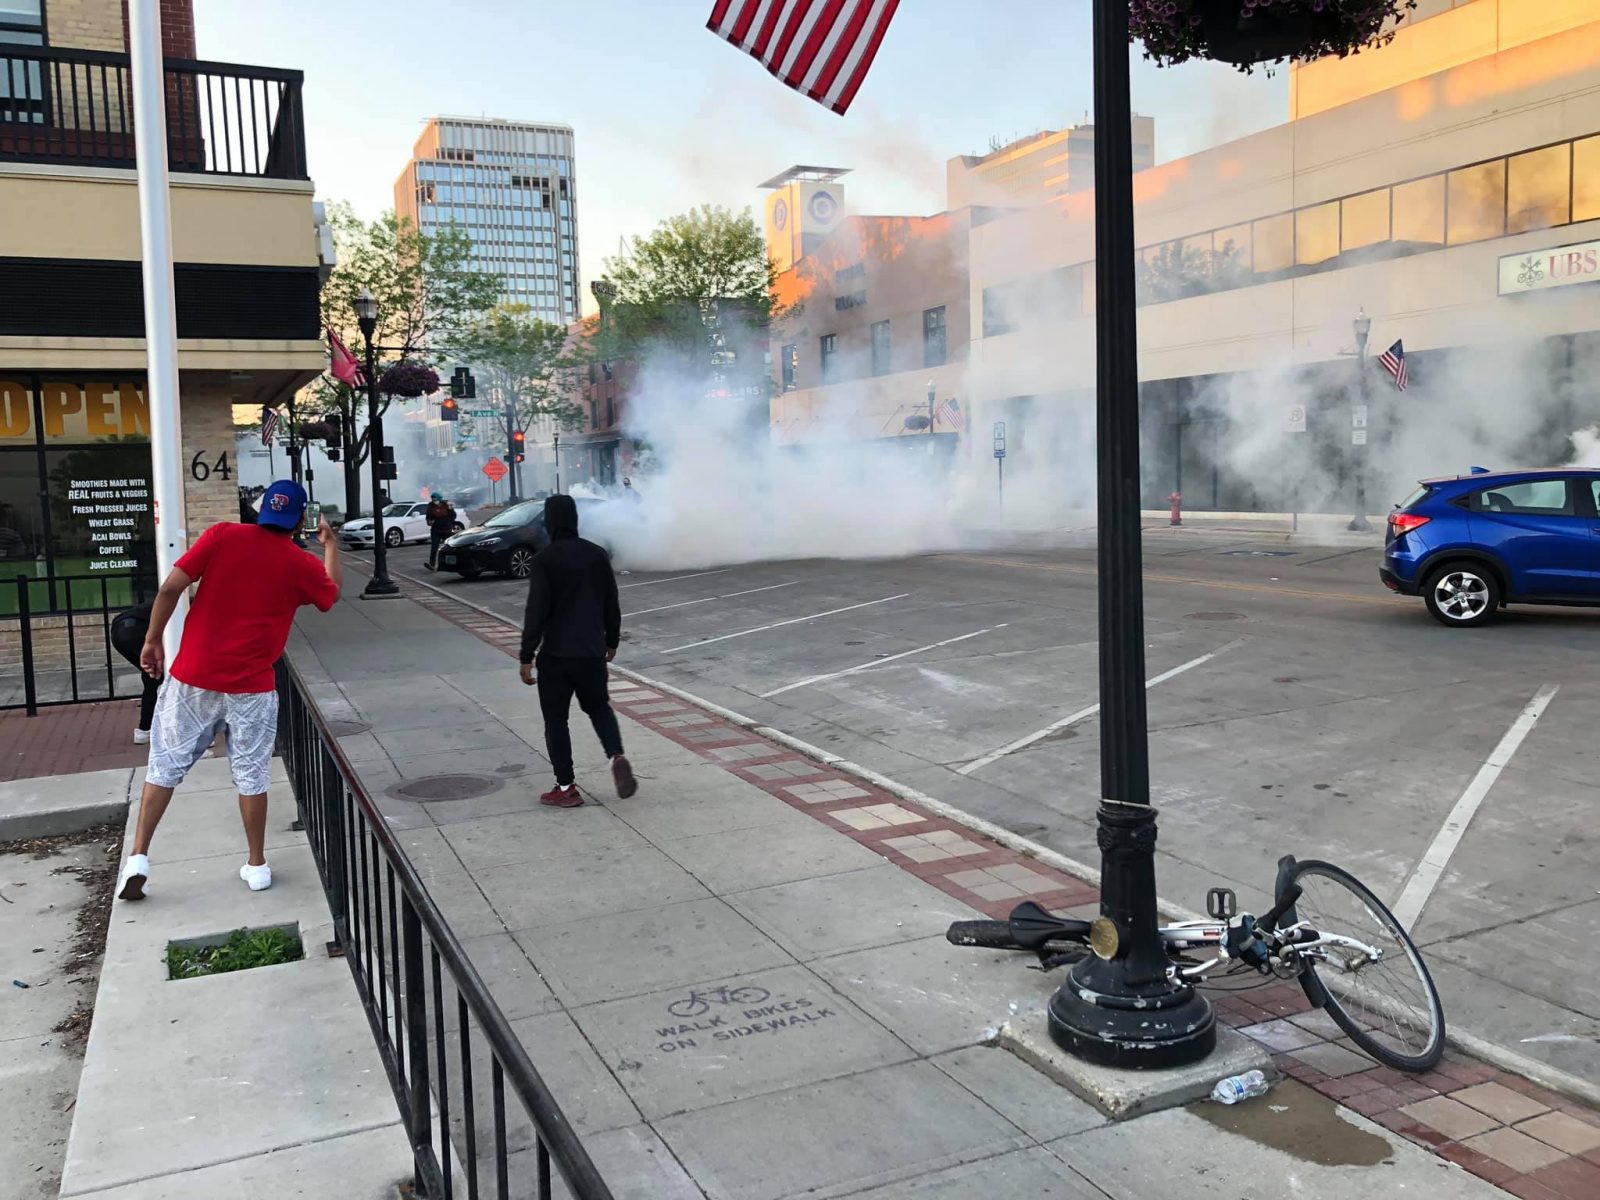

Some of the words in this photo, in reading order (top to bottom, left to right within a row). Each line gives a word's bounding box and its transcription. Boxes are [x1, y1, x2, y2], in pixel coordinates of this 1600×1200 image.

[1548, 249, 1597, 279] UBS
[0, 382, 149, 437] OPEN
[191, 450, 231, 481] 64
[71, 480, 108, 488] SMOOTHIES
[109, 479, 128, 487] MADE
[129, 479, 145, 487] WITH
[68, 490, 89, 499] REAL
[91, 491, 113, 499] FRUITS
[115, 490, 120, 498] &
[72, 505, 94, 514] FRESH
[95, 505, 124, 513] PRESSED
[125, 504, 148, 512] JUICES
[88, 519, 111, 527] WHEAT
[113, 518, 134, 526] GRASS
[92, 533, 107, 541] ACAI
[109, 532, 132, 540] BOWLS
[99, 546, 124, 554] COFFEE
[89, 561, 108, 569] JUICE
[109, 560, 138, 568] CLEANSE
[655, 1015, 728, 1037] WALK
[743, 998, 813, 1020] BIKES
[657, 1038, 697, 1053] ON
[712, 1008, 836, 1041] SIDEWALK
